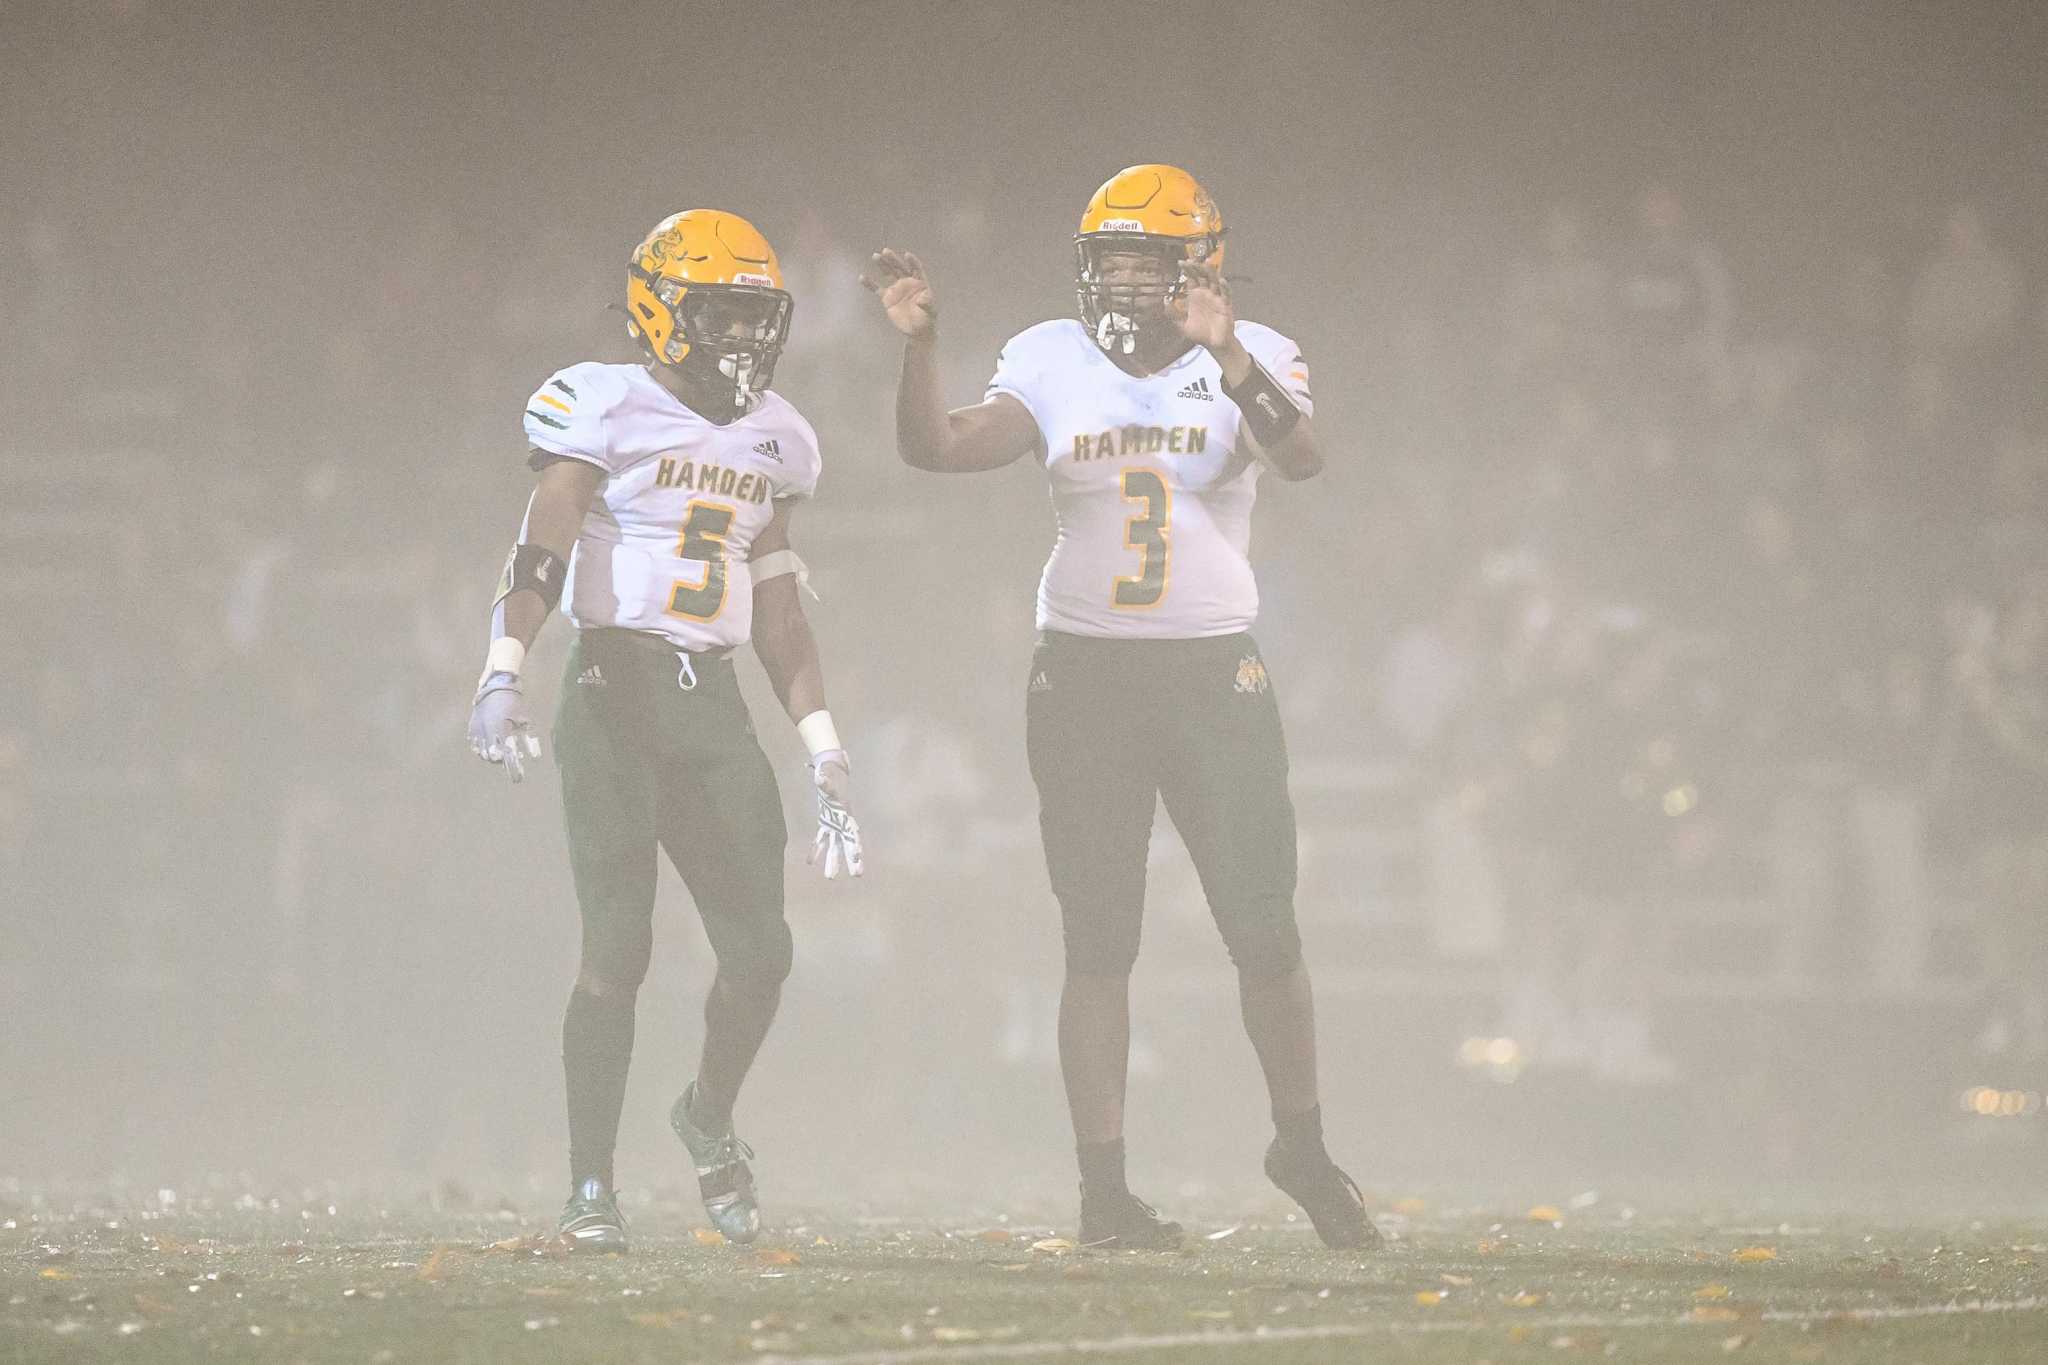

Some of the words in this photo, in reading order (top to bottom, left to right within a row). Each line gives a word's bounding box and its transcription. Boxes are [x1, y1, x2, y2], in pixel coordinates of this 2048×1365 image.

[1177, 389, 1214, 402] adidas
[1073, 425, 1208, 462] HAMDEN
[655, 457, 768, 504] HAMDEN
[664, 498, 736, 624] 5
[1110, 466, 1173, 611] 3
